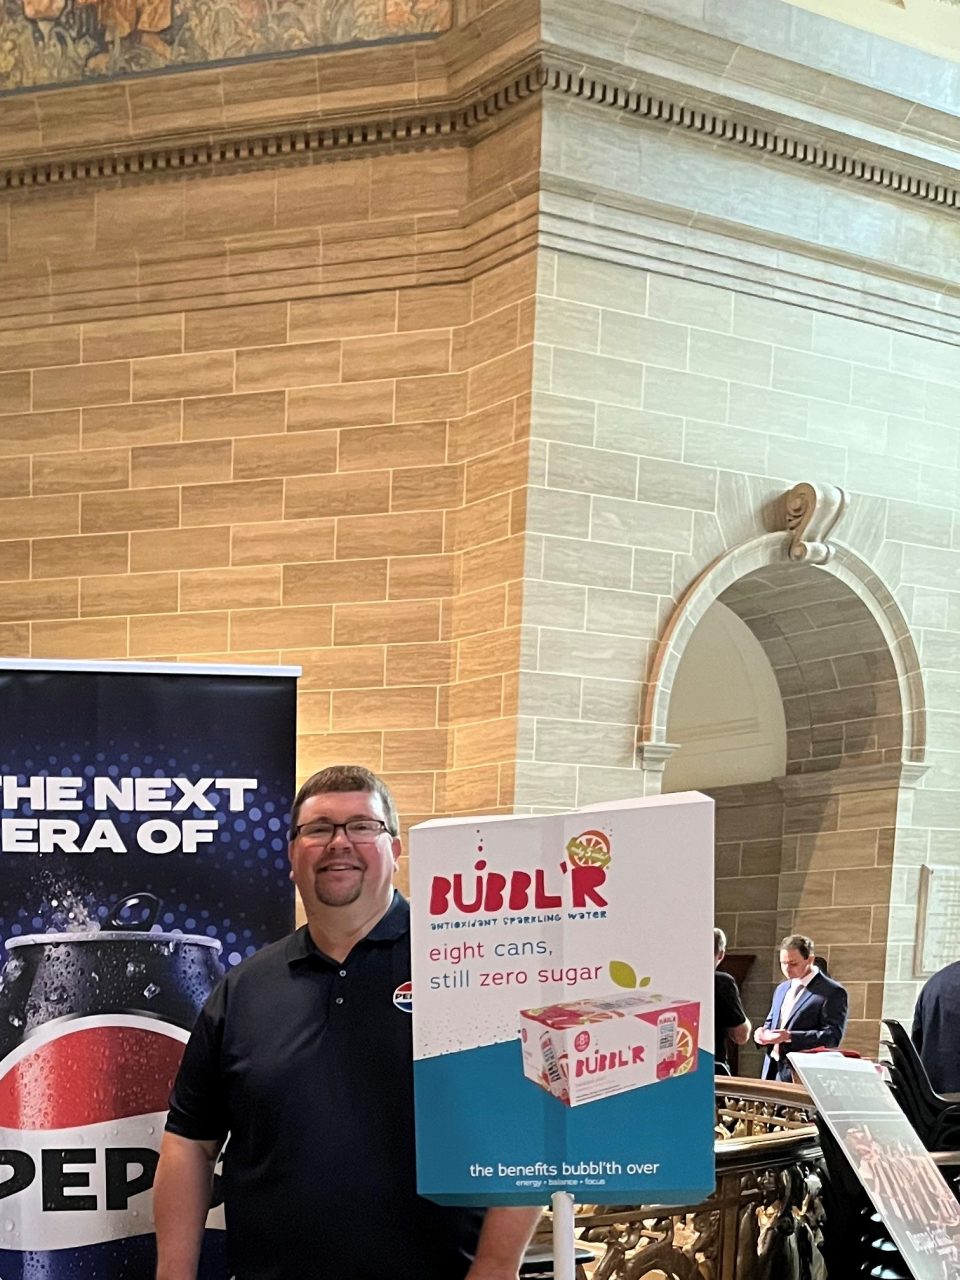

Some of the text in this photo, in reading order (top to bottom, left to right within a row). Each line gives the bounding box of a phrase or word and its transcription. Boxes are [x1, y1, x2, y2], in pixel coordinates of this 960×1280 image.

[94, 777, 258, 812] NEXT
[1, 817, 220, 854] ERA OF
[430, 860, 608, 915] BUBBL'R
[430, 940, 553, 964] eight cans,
[430, 965, 602, 989] still zero sugar
[575, 1044, 646, 1078] BUBBL'R
[469, 1161, 660, 1177] the benefits bubbl'th over
[584, 1177, 606, 1186] focus
